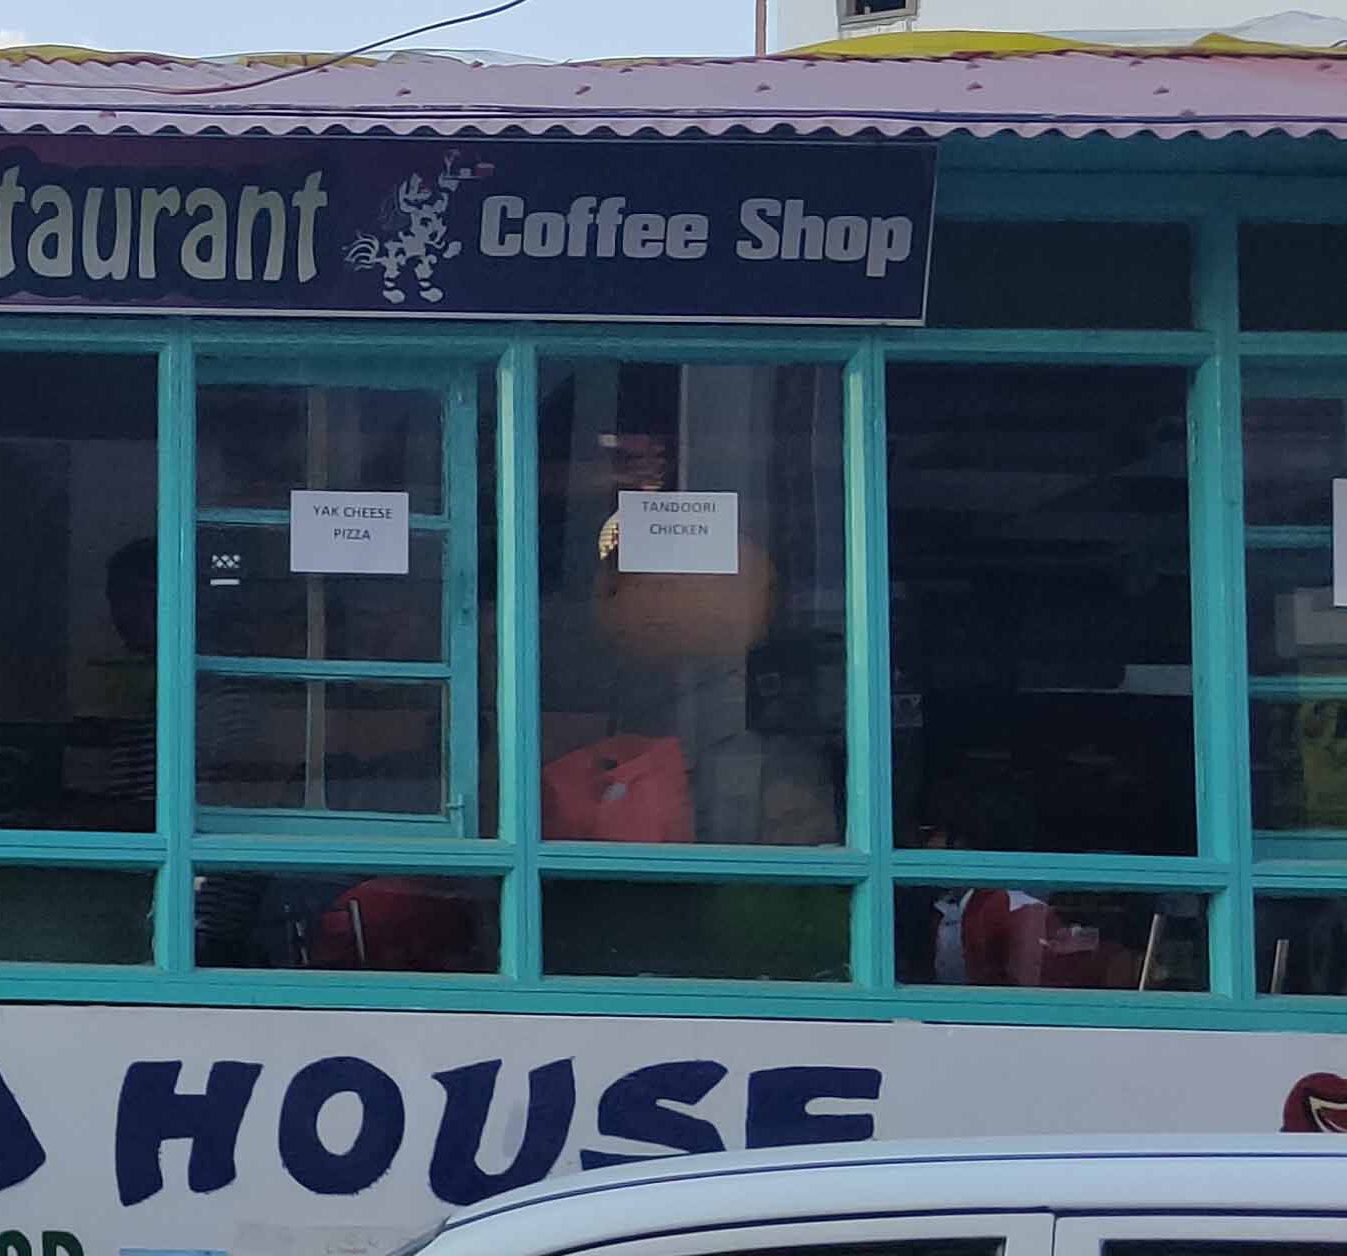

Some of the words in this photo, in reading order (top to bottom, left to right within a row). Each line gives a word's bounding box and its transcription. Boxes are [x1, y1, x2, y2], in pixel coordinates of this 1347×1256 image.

[479, 195, 709, 259] Coffee
[736, 198, 913, 278] Shop
[313, 505, 339, 517] YAK
[343, 506, 393, 519] CHEESE
[641, 501, 716, 513] TANDOORI
[333, 528, 371, 540] PIZZA
[649, 523, 708, 535] CHICKEN
[114, 1055, 883, 1208] HOUSE
